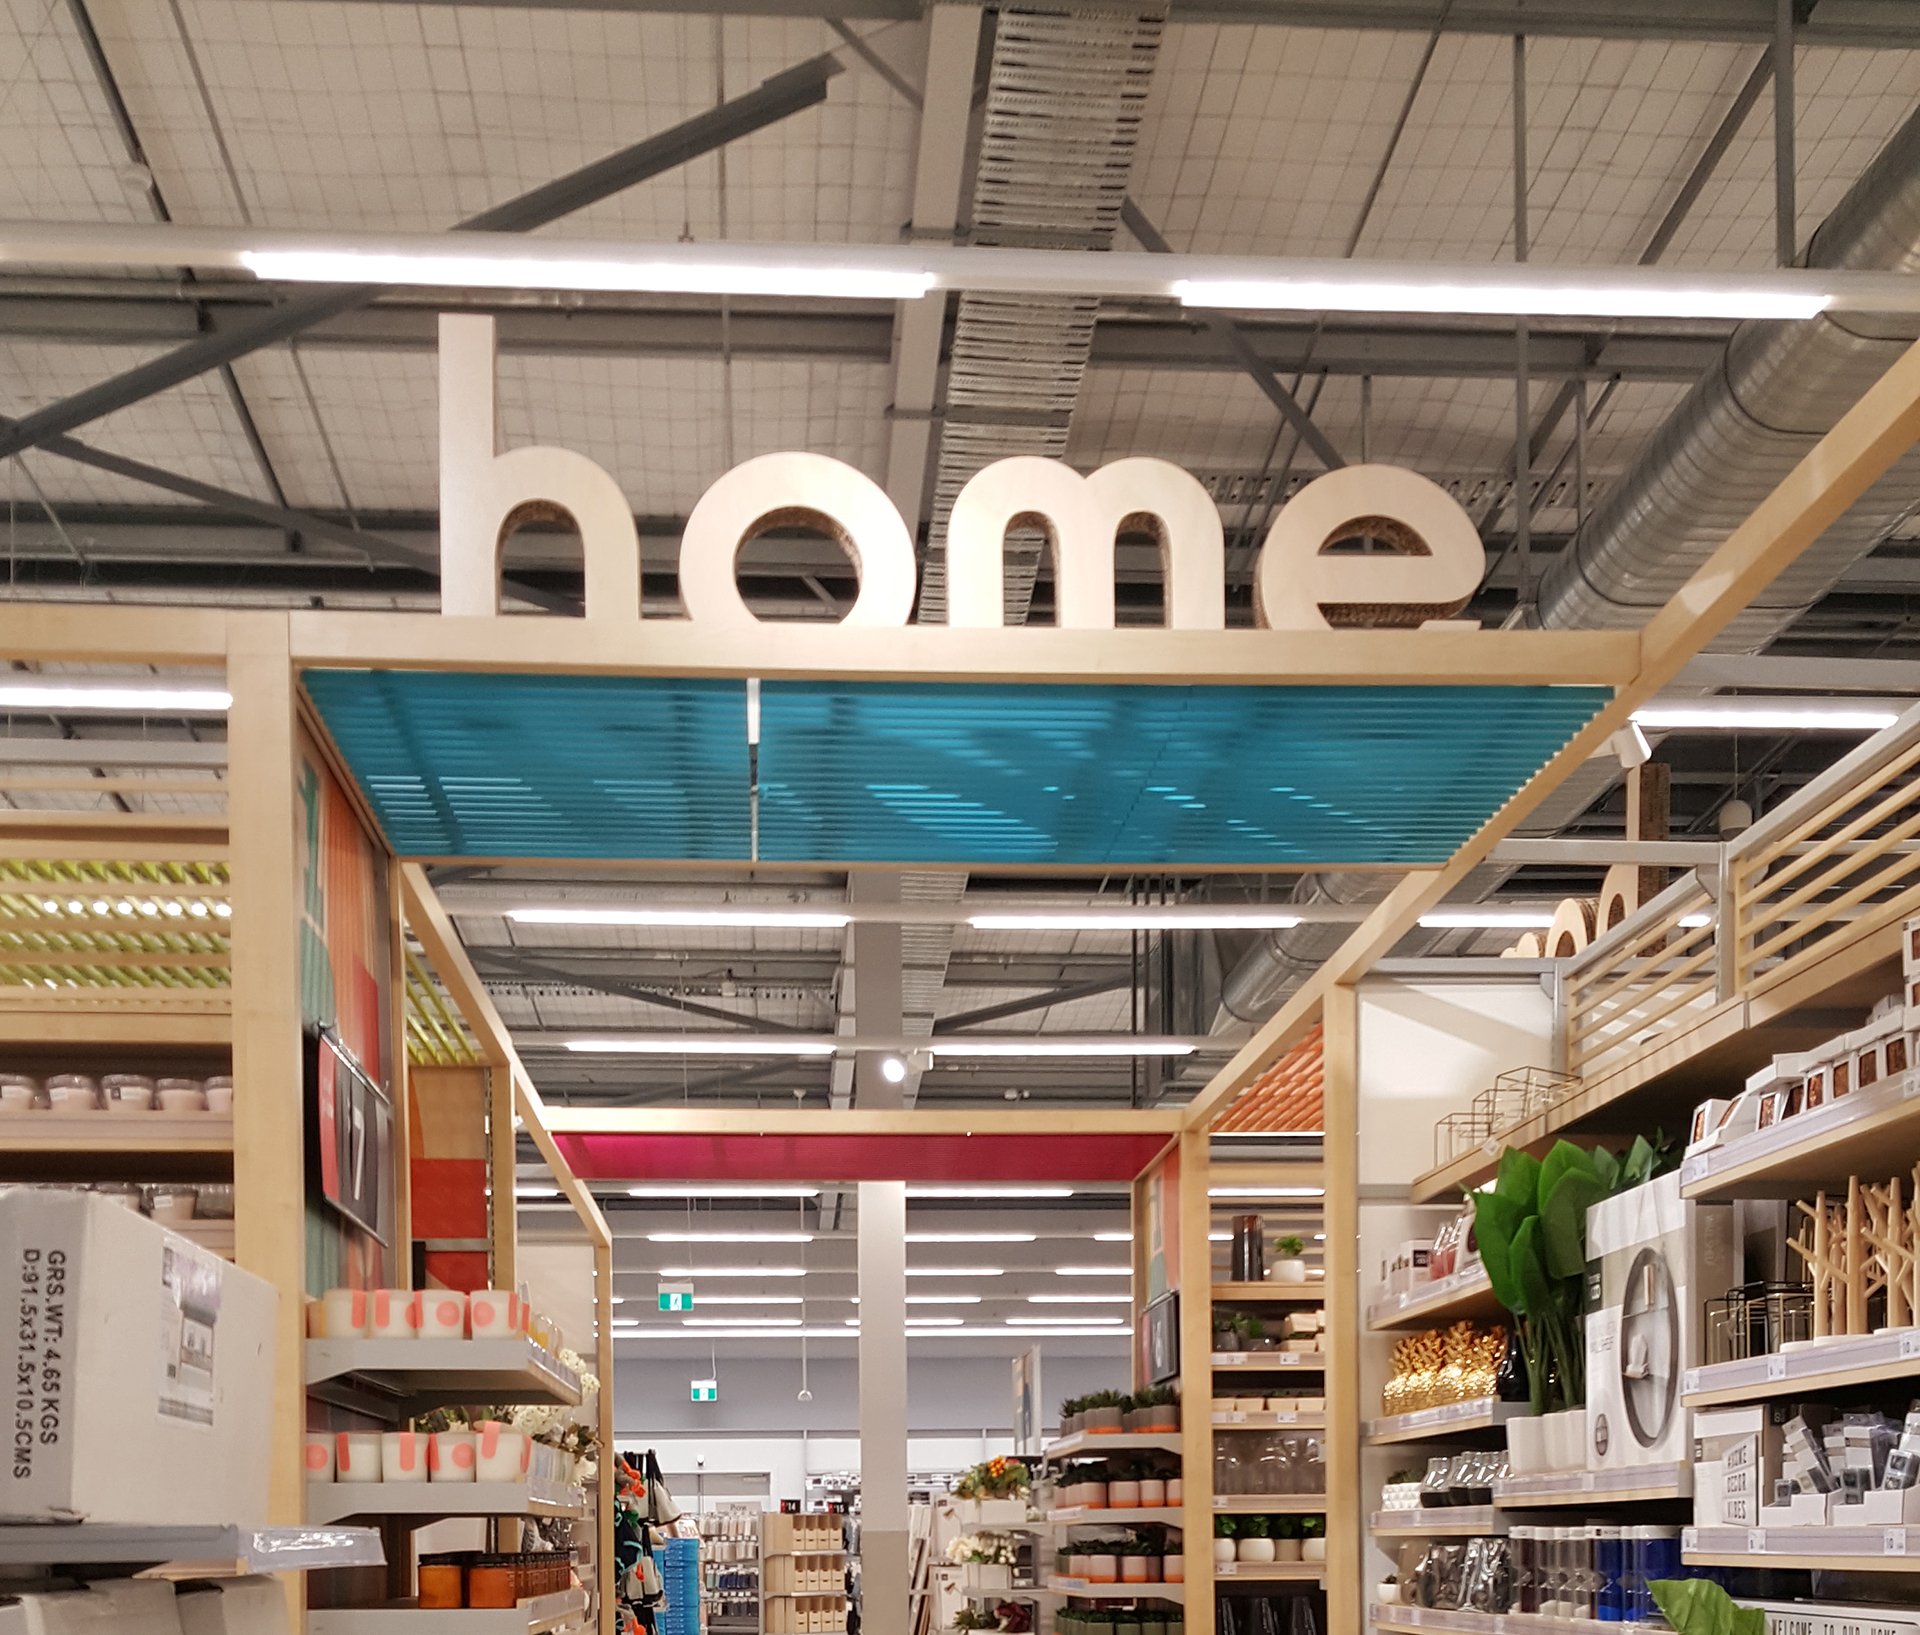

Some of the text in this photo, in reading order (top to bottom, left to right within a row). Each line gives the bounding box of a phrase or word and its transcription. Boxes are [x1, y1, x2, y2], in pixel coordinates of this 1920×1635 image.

[438, 313, 1486, 631] home
[41, 1349, 62, 1393] 4.65
[39, 1398, 60, 1446] KGS
